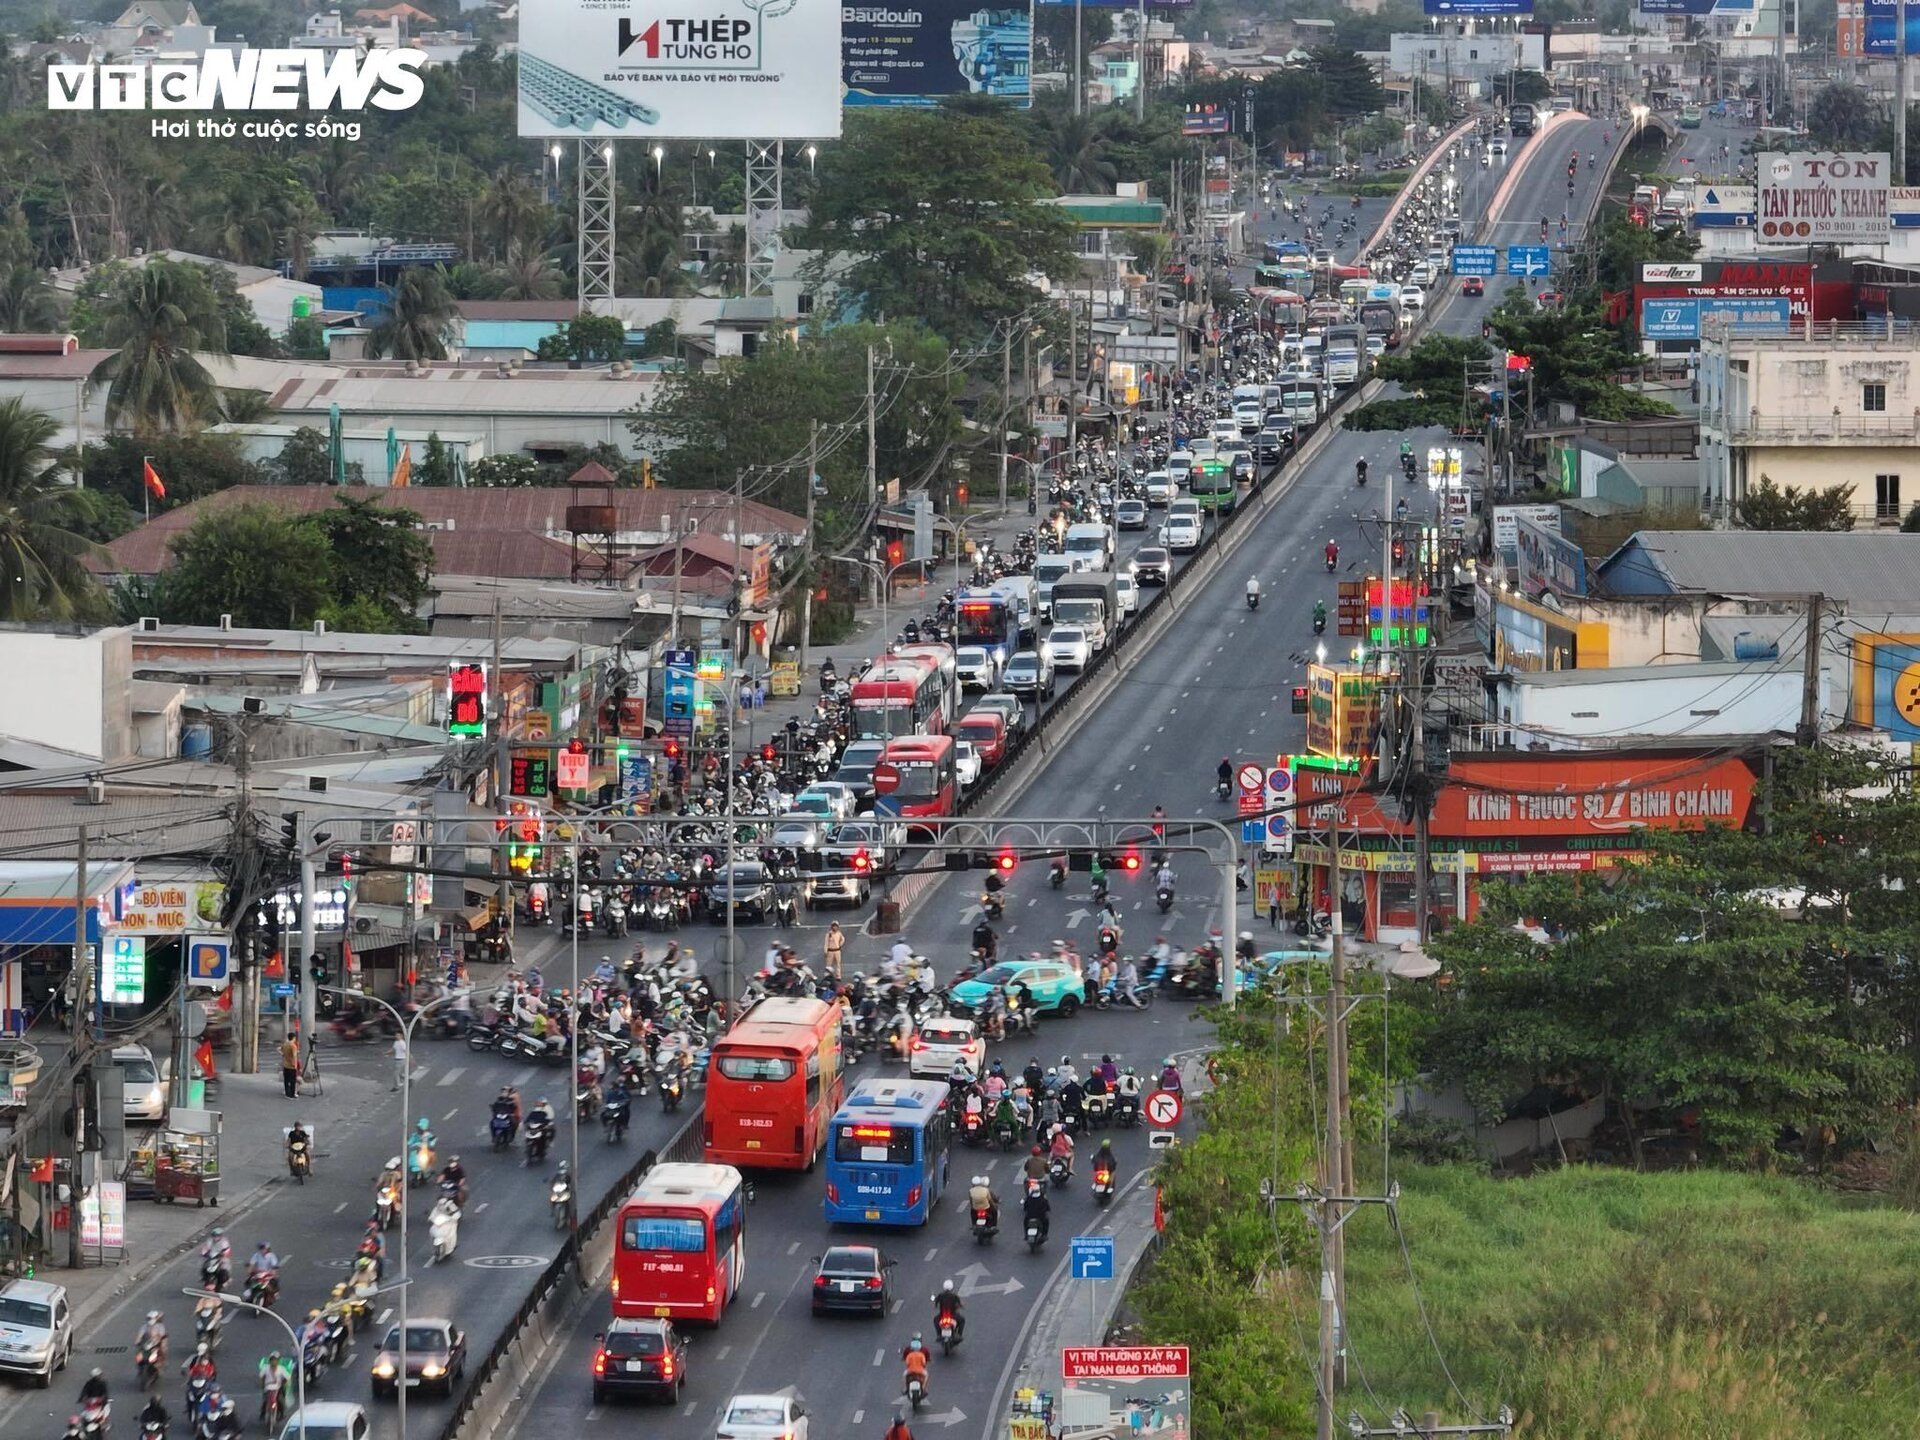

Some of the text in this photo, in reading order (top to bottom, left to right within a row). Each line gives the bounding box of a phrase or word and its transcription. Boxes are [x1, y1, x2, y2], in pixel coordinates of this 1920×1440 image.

[842, 7, 922, 23] Baudouin
[666, 14, 752, 42] THÉP
[662, 44, 752, 59] TUNG HO
[1803, 154, 1879, 178] TÔN
[1762, 180, 1888, 218] TÂN PHƯỚC KHANH
[1815, 221, 1831, 231] ISO
[1834, 221, 1855, 231] 9001
[1865, 221, 1888, 231] 2015
[1720, 264, 1809, 282] MAXXIS
[1312, 773, 1341, 795] KÍNH
[1675, 783, 1733, 817] CHÁNH
[1069, 1352, 1079, 1363] VỊ
[1081, 1350, 1098, 1361] TRÍ
[1166, 1351, 1181, 1360] RA
[1073, 1365, 1088, 1374] TAI
[1115, 1365, 1140, 1375] GIAO
[1142, 1363, 1177, 1374] THÔNG
